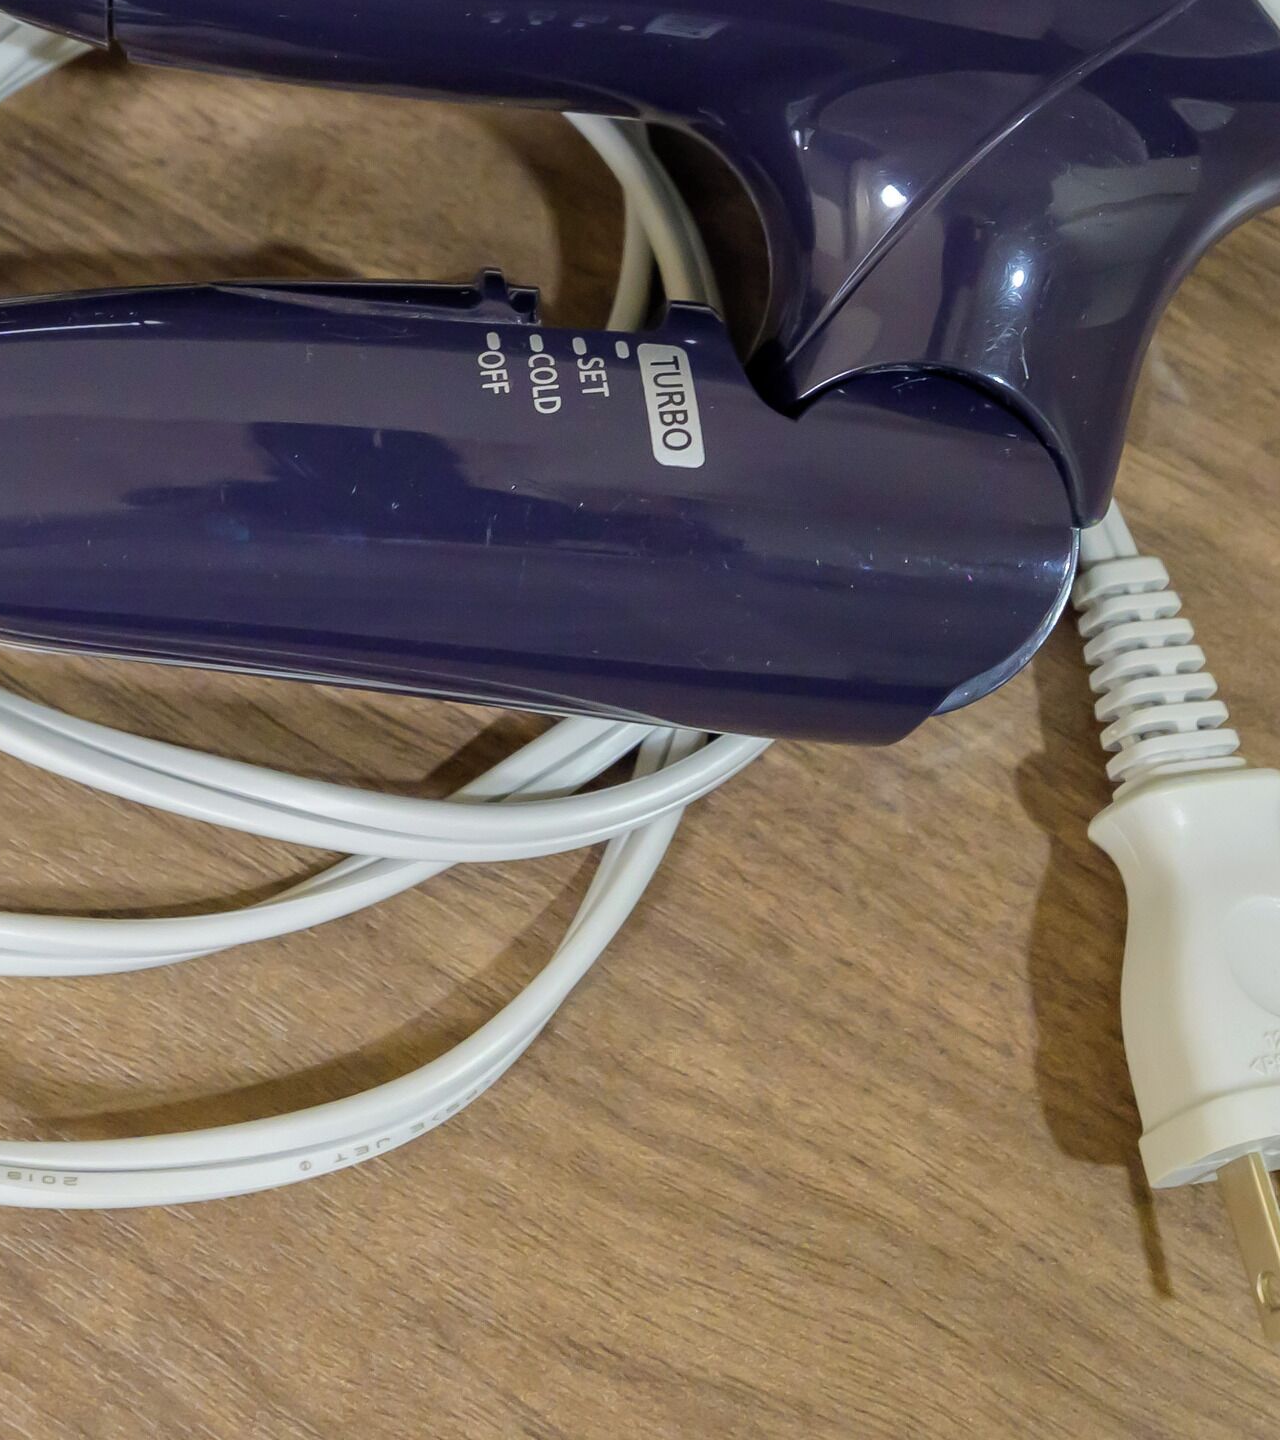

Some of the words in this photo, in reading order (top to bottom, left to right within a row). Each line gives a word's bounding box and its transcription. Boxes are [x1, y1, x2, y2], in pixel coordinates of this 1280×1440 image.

[477, 350, 510, 394] OFF
[528, 352, 562, 414] COLD
[576, 356, 610, 398] SET
[649, 355, 693, 452] TURBO
